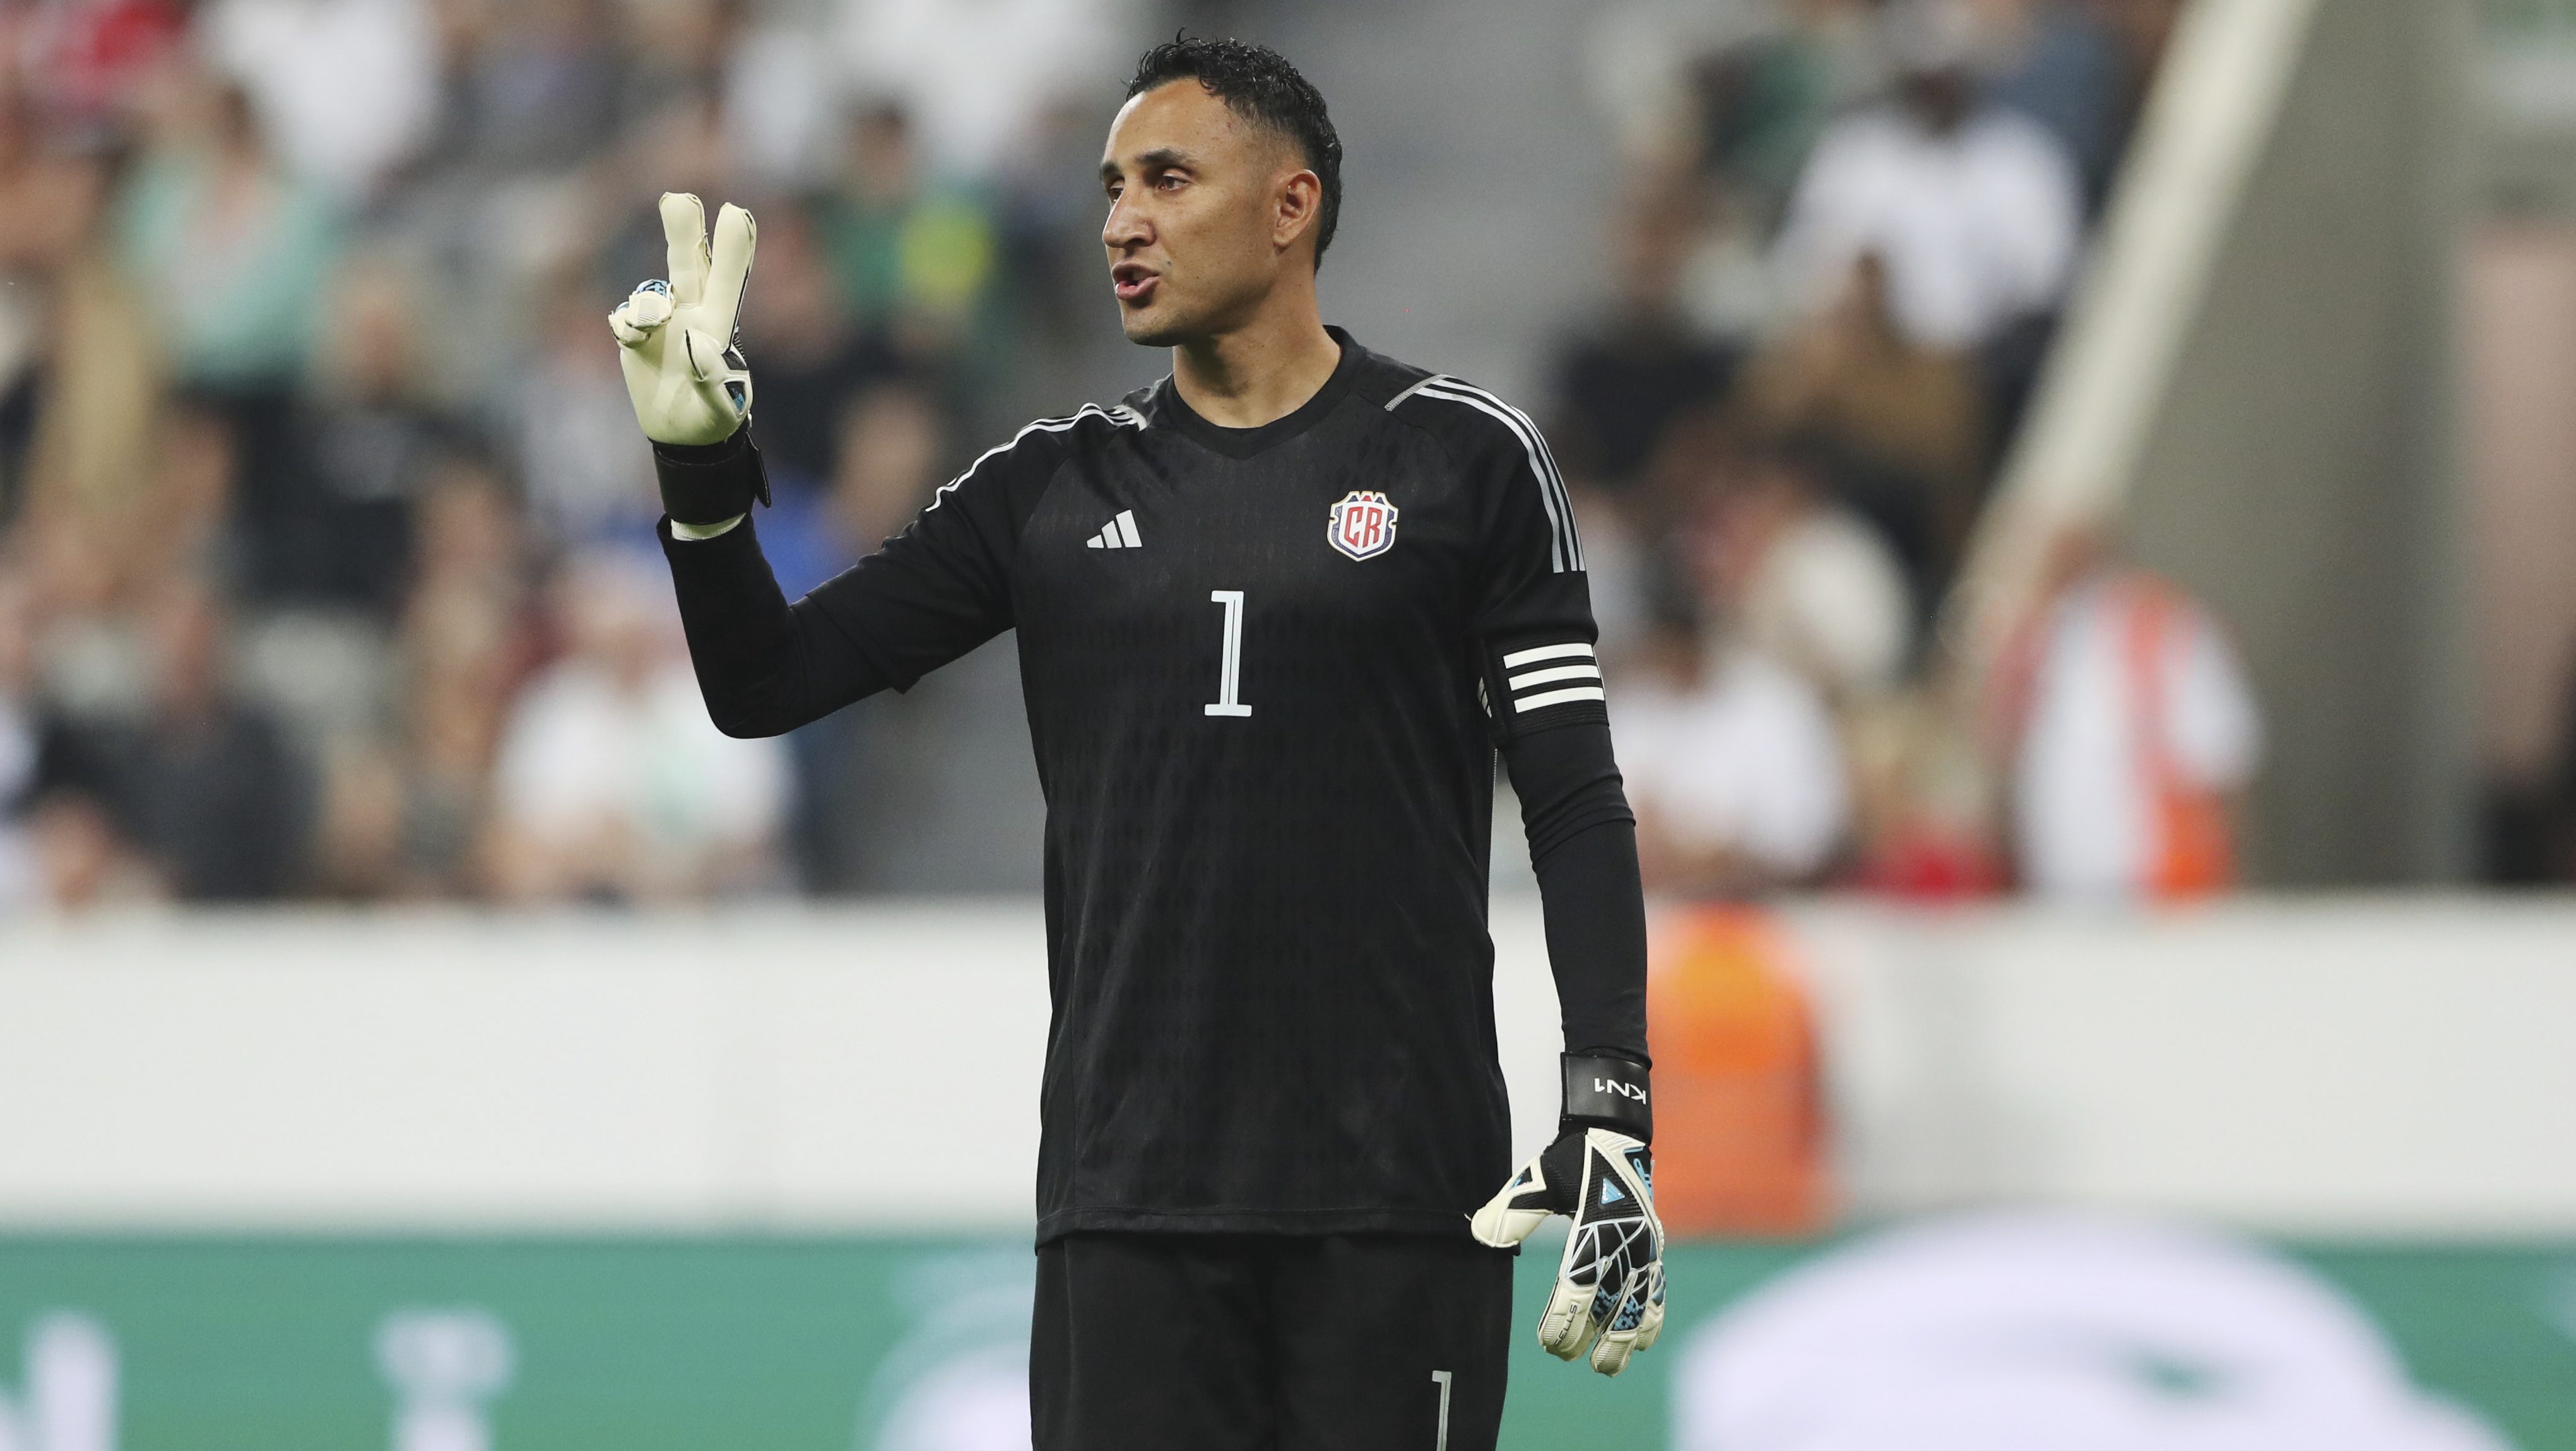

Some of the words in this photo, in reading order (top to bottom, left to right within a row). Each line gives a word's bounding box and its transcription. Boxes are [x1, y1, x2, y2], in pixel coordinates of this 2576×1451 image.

[1344, 506, 1383, 548] CR
[1204, 590, 1252, 716] 1
[1594, 1077, 1646, 1105] KN1
[1554, 1303, 1578, 1346] SELLS
[1431, 1370, 1451, 1451] 1
